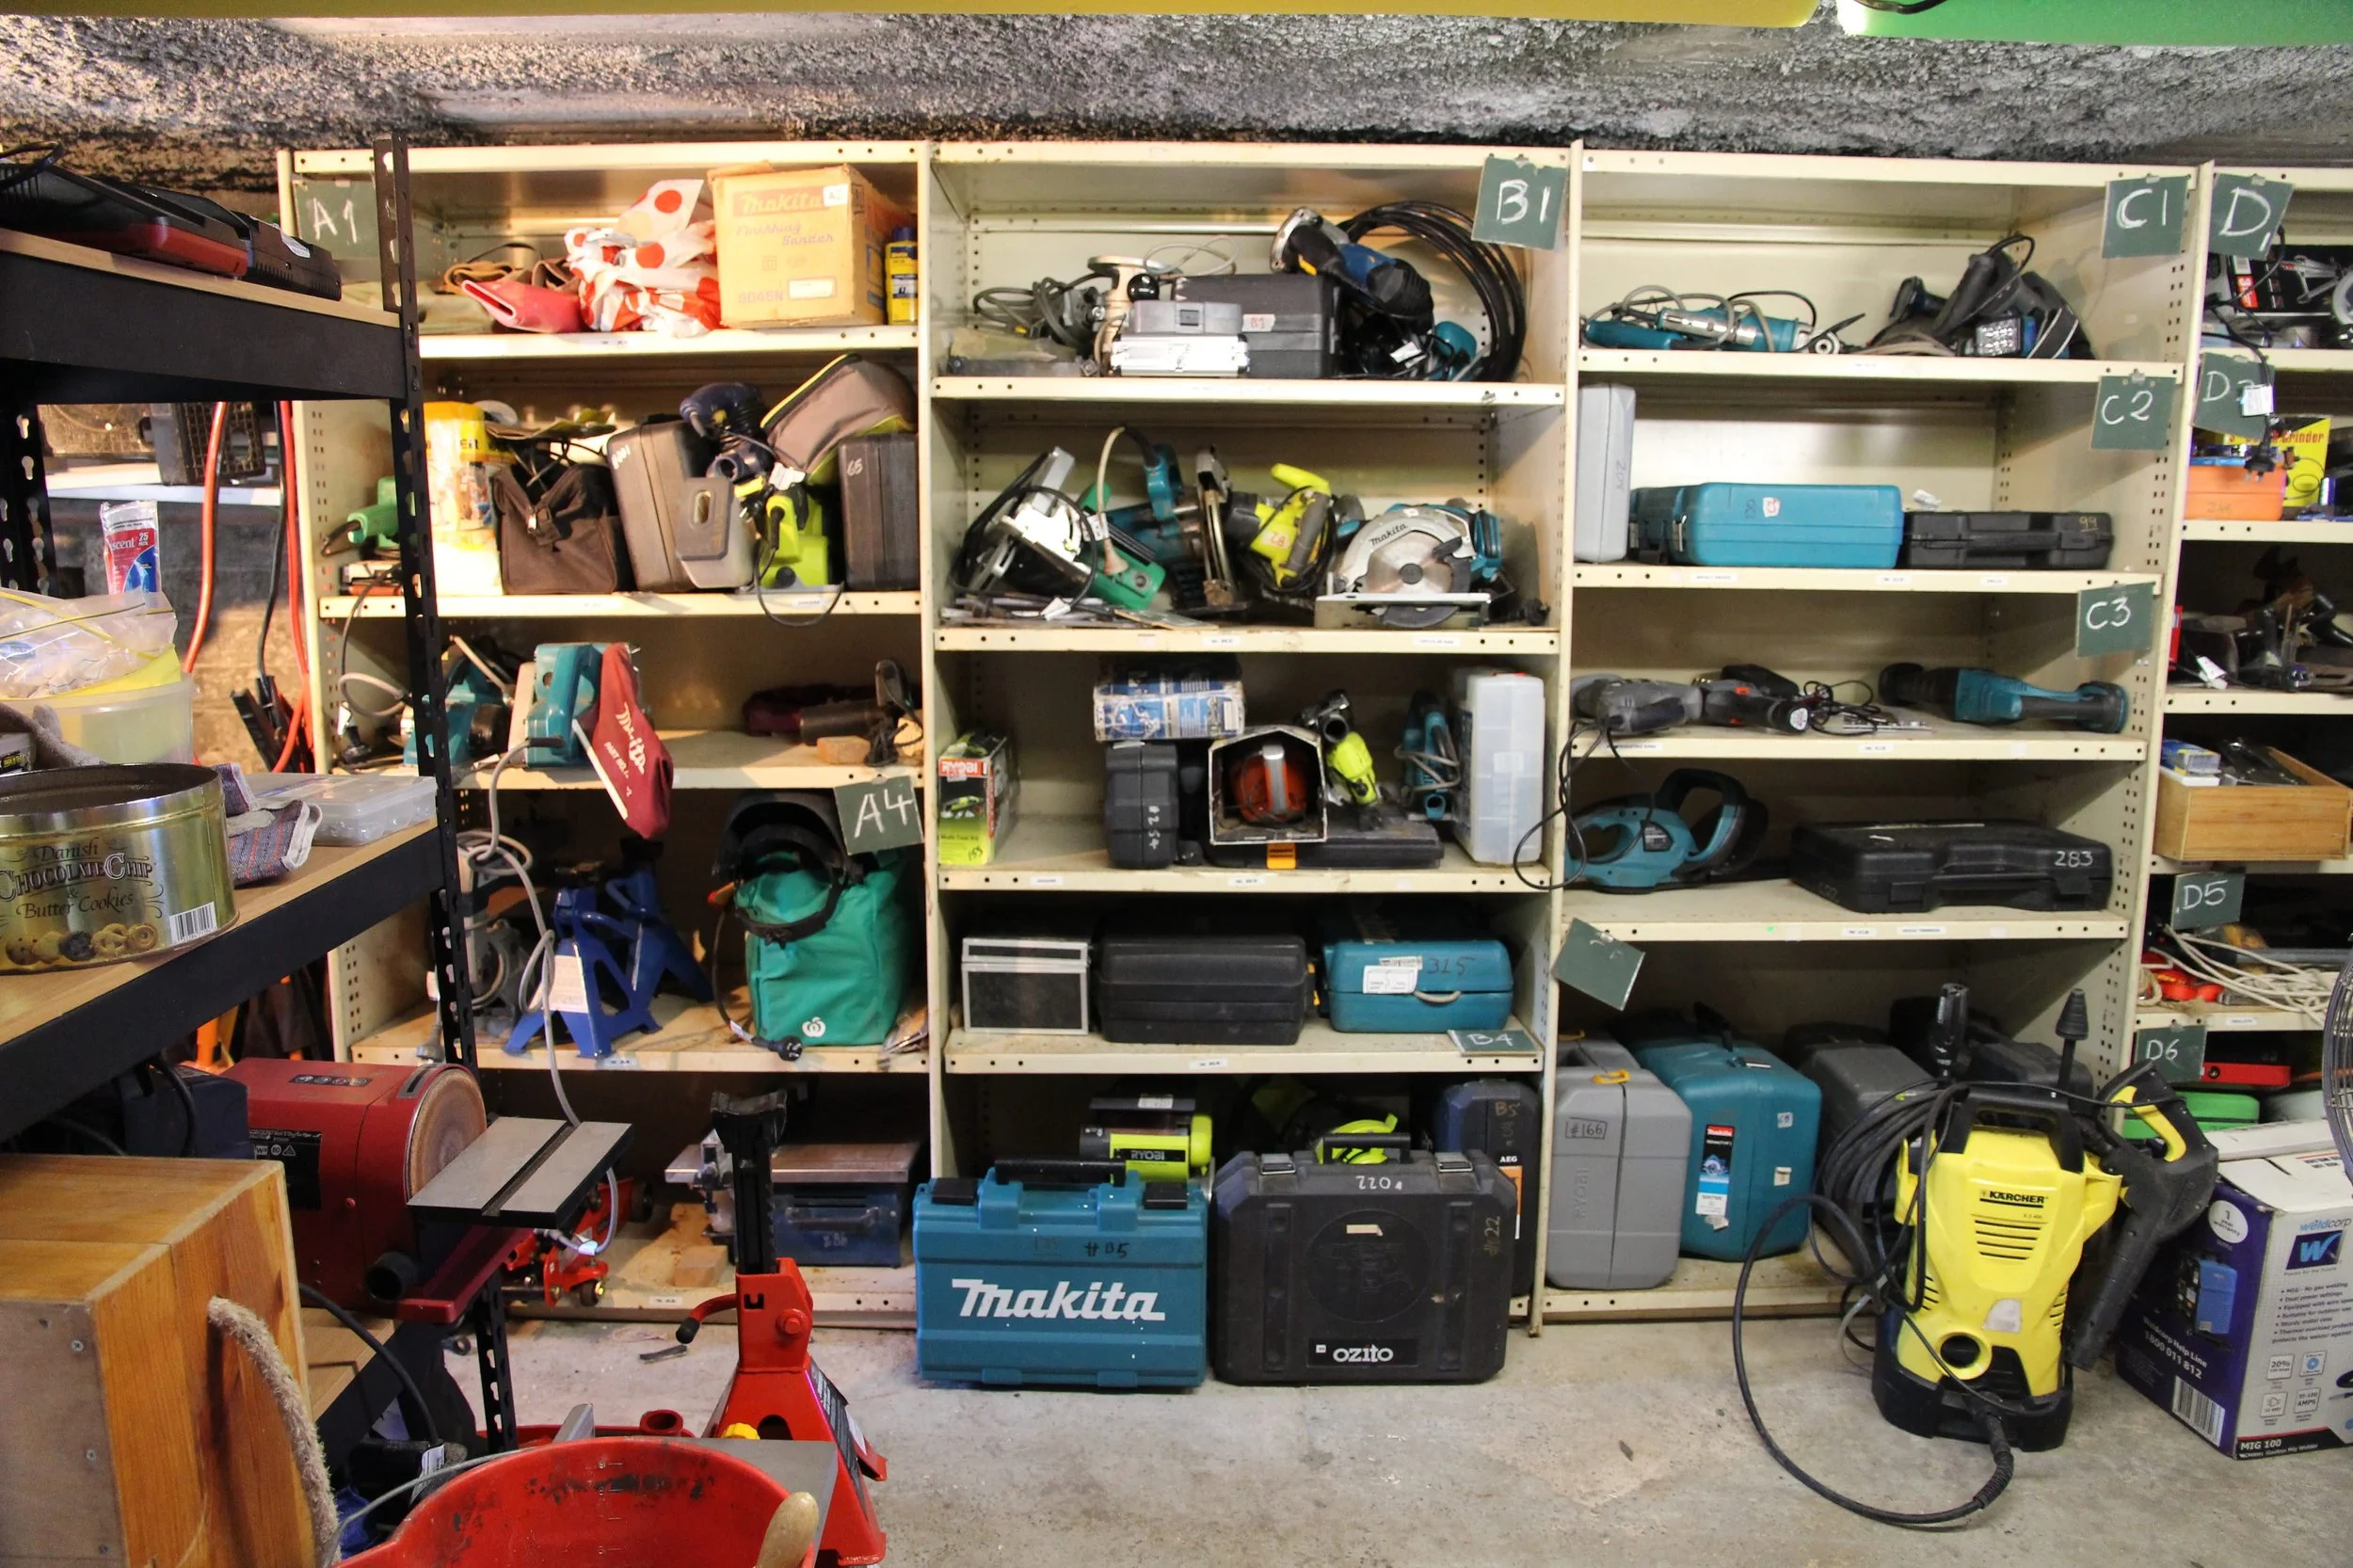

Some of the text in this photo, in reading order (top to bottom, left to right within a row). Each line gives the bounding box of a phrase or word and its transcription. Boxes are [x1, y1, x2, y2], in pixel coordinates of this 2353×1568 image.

[1496, 178, 1550, 226] B1
[2116, 187, 2169, 231] C1
[312, 196, 358, 245] A1
[2100, 389, 2154, 427] C2
[846, 456, 864, 477] 65
[2078, 516, 2099, 532] 99
[138, 532, 149, 542] 25
[2086, 596, 2133, 631] C3
[852, 789, 915, 840] A4
[40, 837, 99, 862] Danish
[2053, 849, 2095, 869] 283
[16, 887, 134, 920] Butter Cookies
[2182, 879, 2230, 910] D5
[1467, 1033, 1513, 1048] B4
[2145, 1037, 2181, 1062] D6
[1570, 1119, 1604, 1137] #166
[1130, 1150, 1166, 1160] RYOBI
[1498, 1155, 1518, 1163] AEG
[2224, 1209, 2231, 1221] 1
[2299, 1218, 2352, 1232] weldcorp
[2212, 1220, 2241, 1238] warranty
[1332, 1343, 1395, 1364] ozito
[2145, 1330, 2165, 1354] 1800
[2182, 1358, 2202, 1380] 812
[2172, 1339, 2189, 1360] Help
[2189, 1350, 2207, 1368] Line
[2240, 1438, 2282, 1450] MIG 100
